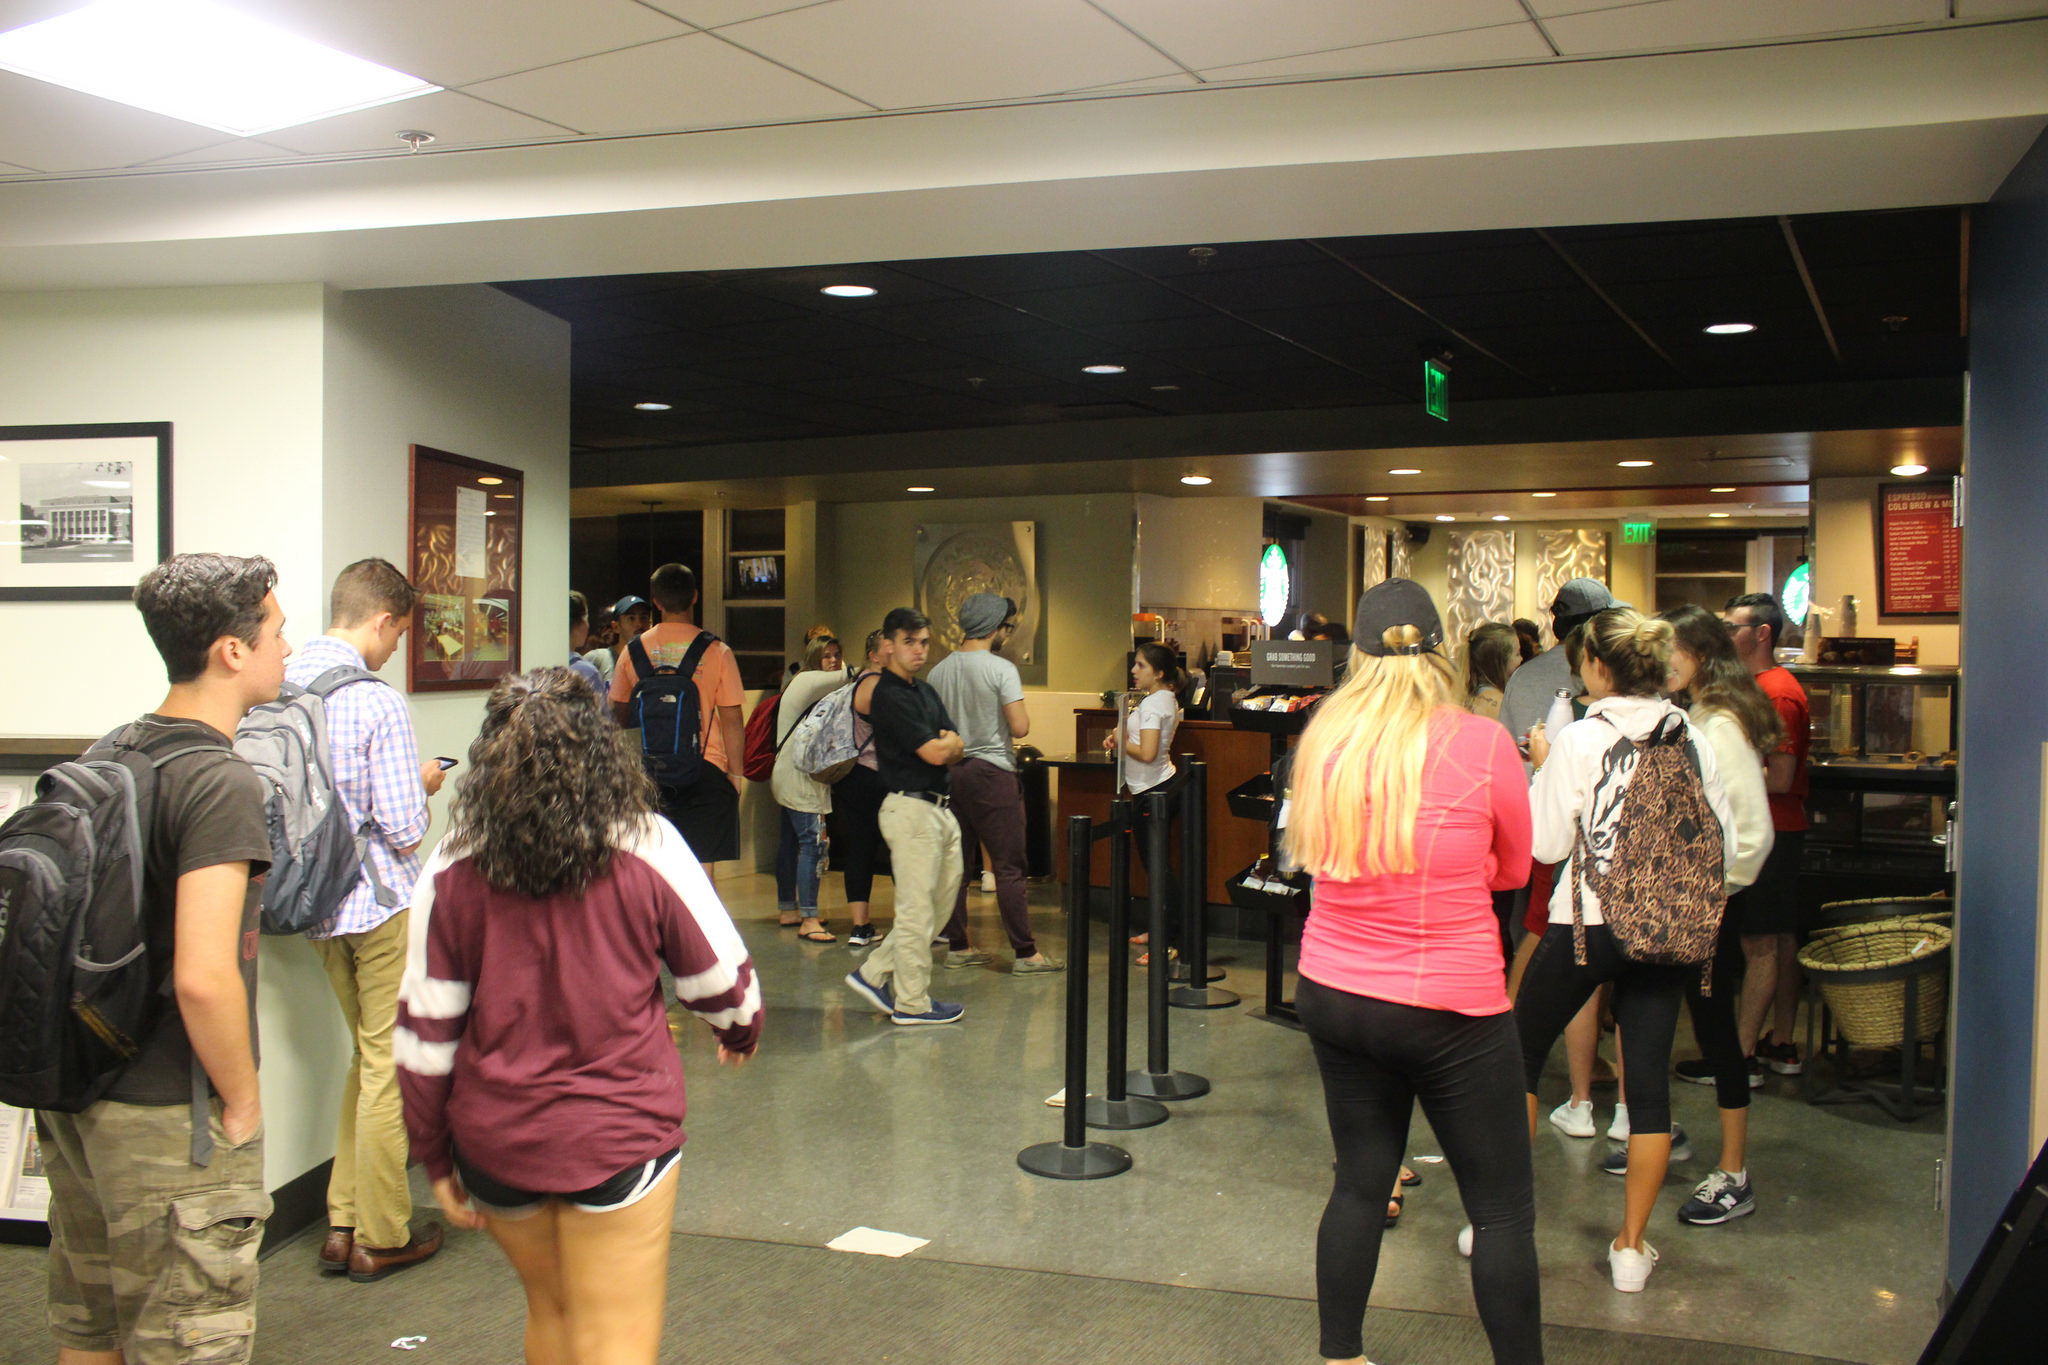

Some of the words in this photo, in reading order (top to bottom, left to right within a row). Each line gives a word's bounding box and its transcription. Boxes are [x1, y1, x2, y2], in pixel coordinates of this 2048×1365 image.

[1888, 493, 1926, 501] ESPRESSO
[1888, 502, 1907, 511] COLD
[1909, 501, 1932, 510] BREW
[1933, 501, 1940, 509] &
[1624, 523, 1651, 543] EXIT
[1267, 653, 1278, 661] GRAB
[1279, 653, 1302, 661] SOMETHING
[1303, 653, 1315, 662] GOOD
